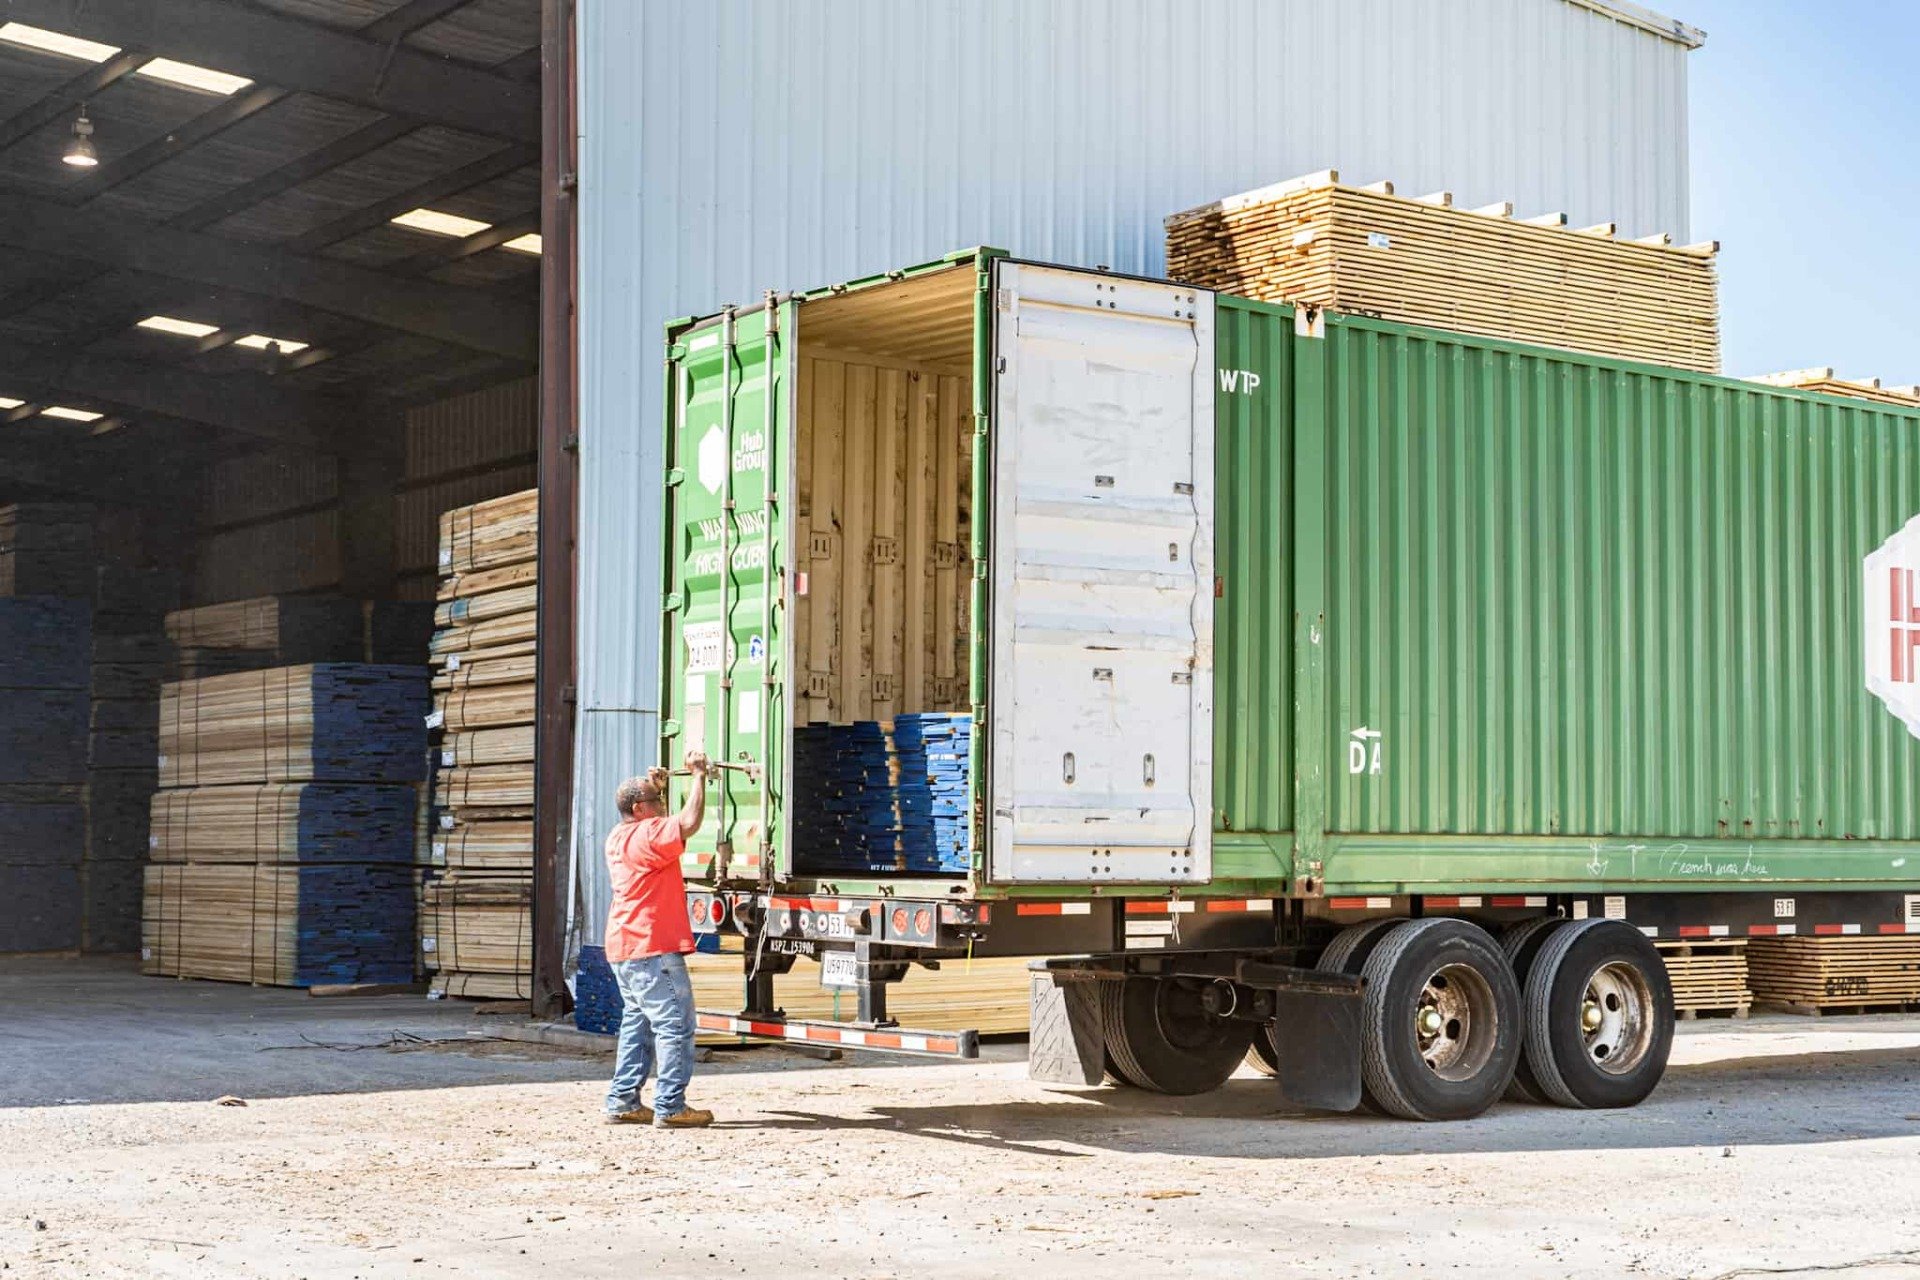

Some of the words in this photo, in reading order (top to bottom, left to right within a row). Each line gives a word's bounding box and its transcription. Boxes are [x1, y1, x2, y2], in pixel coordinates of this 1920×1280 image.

[1220, 368, 1261, 395] WTP
[741, 430, 764, 452] Hub
[1350, 741, 1382, 775] DA
[1776, 900, 1784, 915] 53
[1787, 900, 1794, 915] FT
[830, 916, 841, 934] 53
